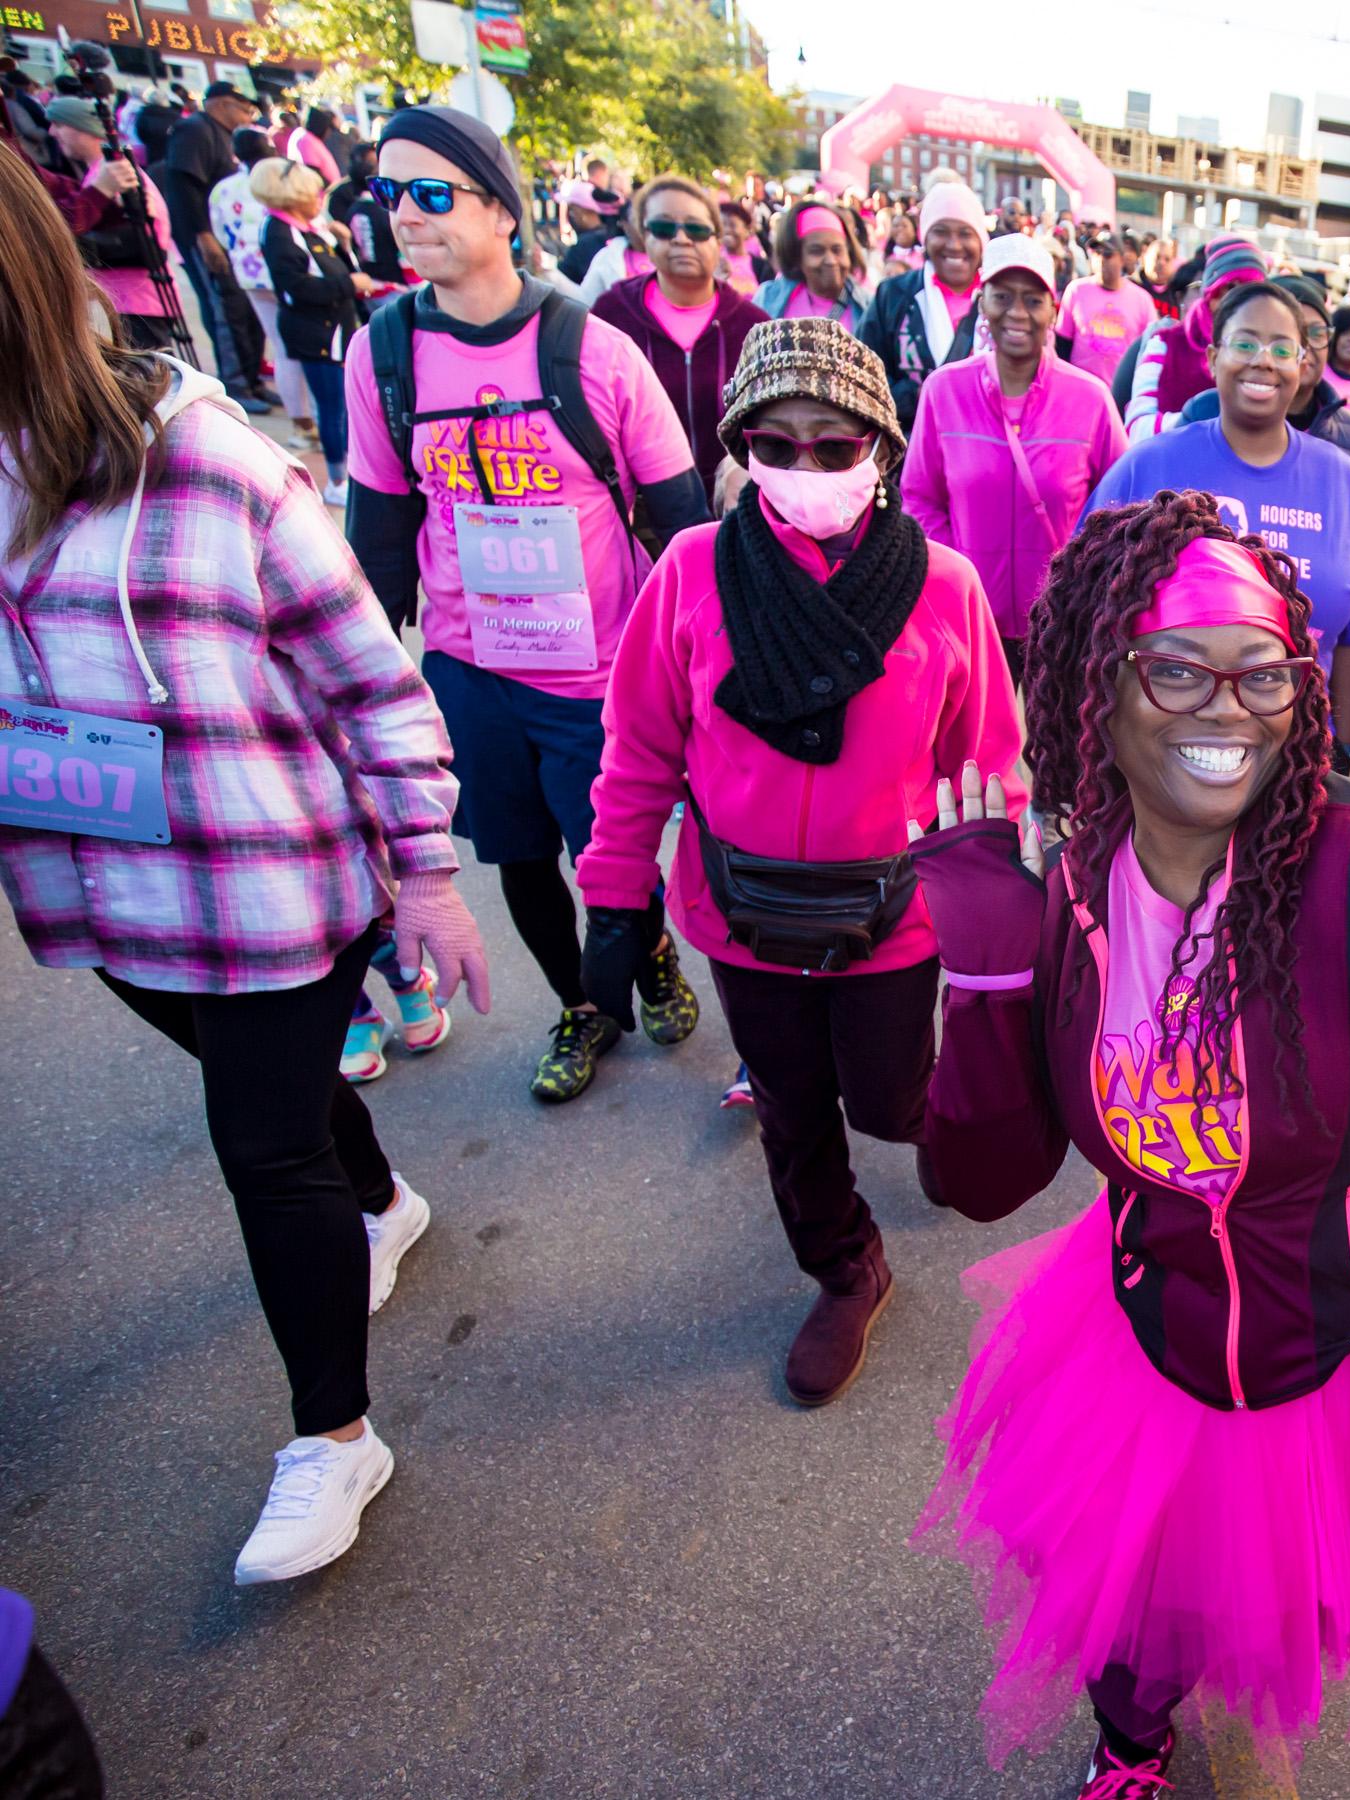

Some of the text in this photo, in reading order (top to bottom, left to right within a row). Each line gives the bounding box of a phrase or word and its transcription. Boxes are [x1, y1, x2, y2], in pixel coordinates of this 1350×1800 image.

[1260, 504, 1322, 532] HOUSERS
[480, 536, 560, 574] 961
[1260, 529, 1288, 549] FOR
[484, 616, 584, 634] In Memory Of
[0, 744, 136, 813] 1307
[1096, 1017, 1246, 1106] Wal
